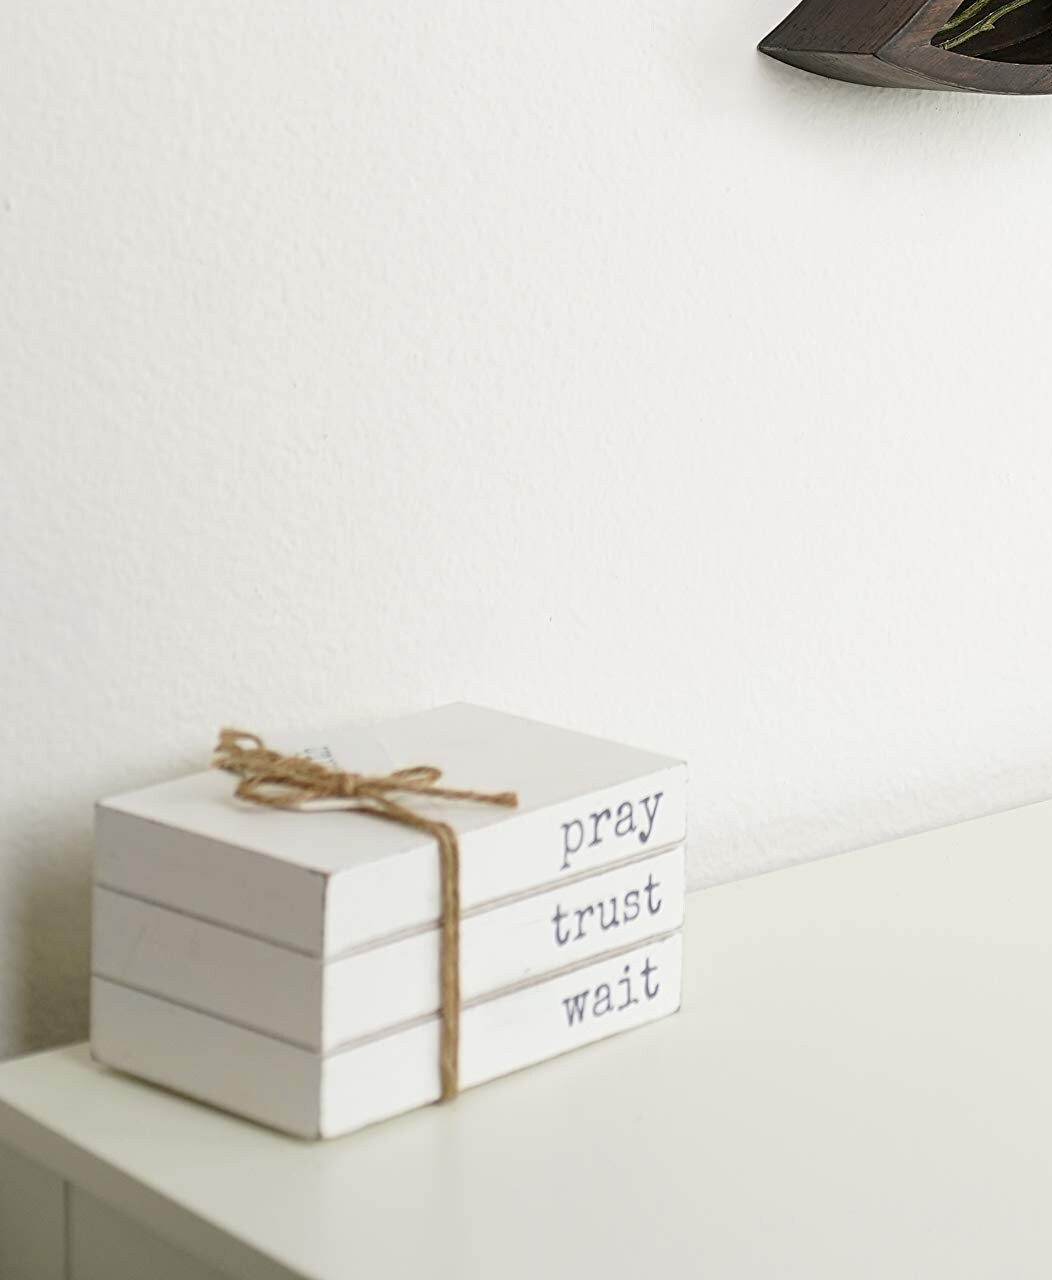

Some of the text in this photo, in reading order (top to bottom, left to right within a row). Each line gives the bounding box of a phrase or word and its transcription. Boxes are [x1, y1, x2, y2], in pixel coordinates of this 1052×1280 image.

[560, 792, 664, 871] pray
[551, 873, 662, 947] trust
[562, 957, 660, 1027] wait
